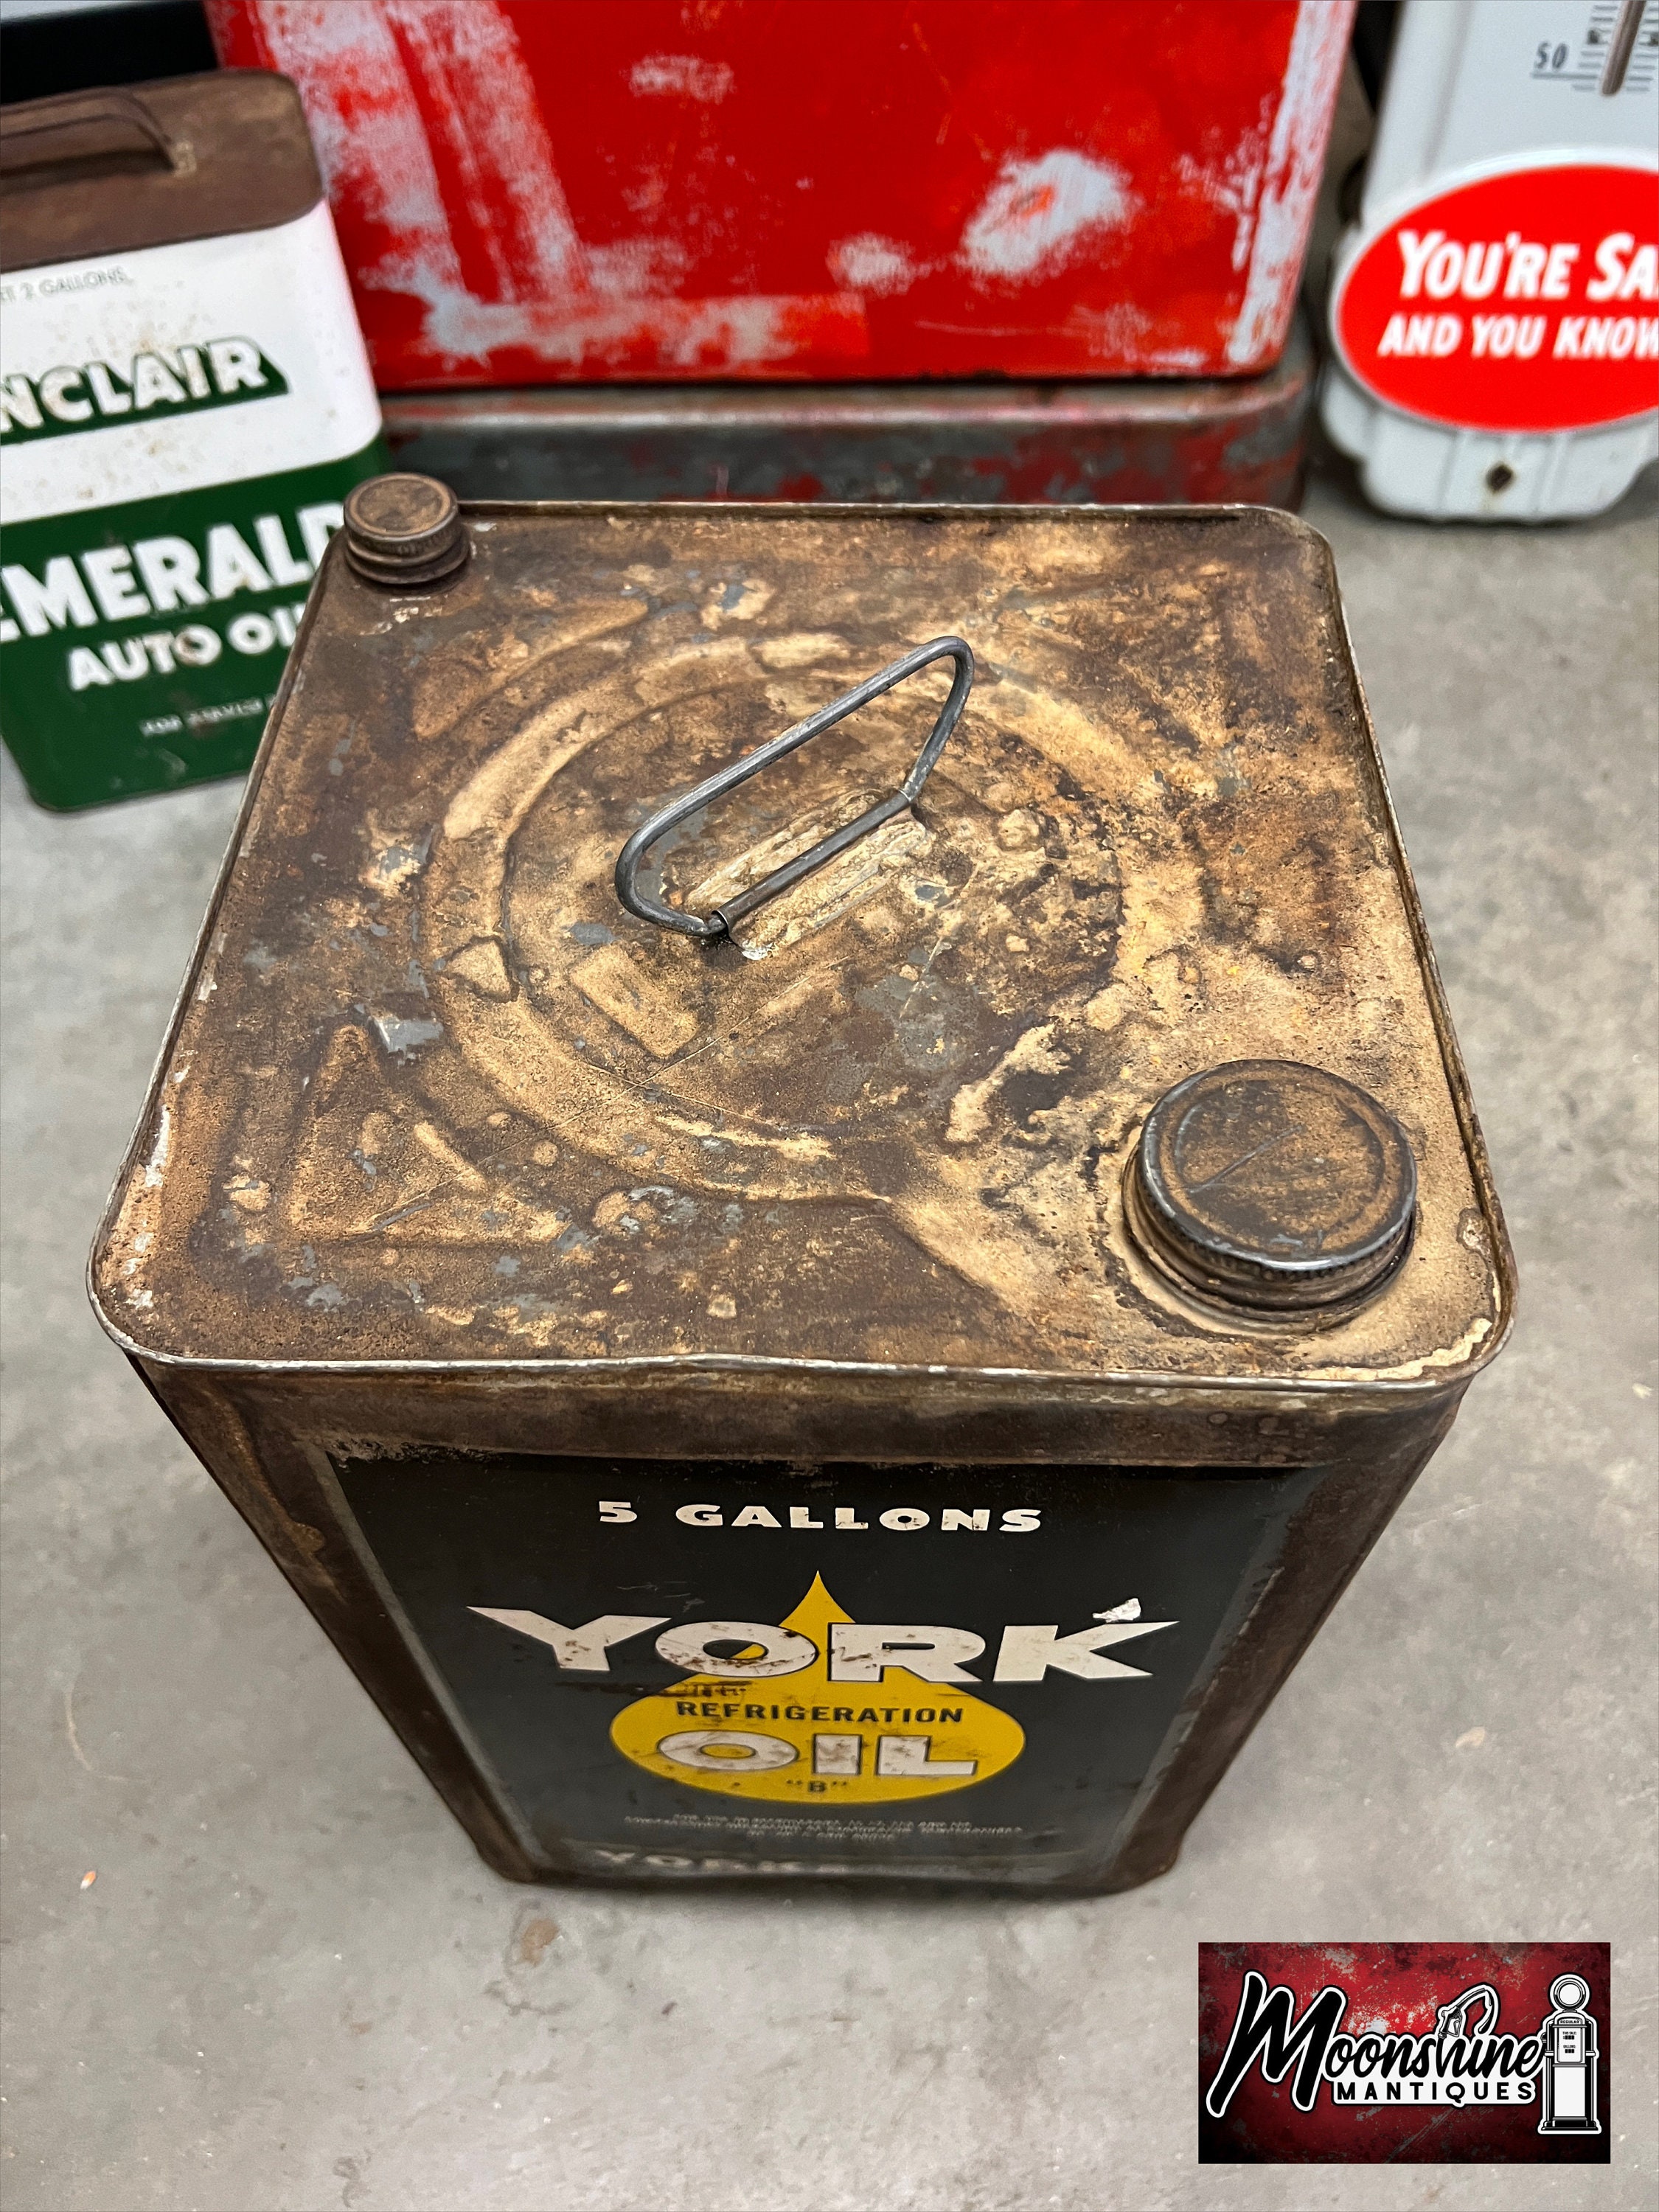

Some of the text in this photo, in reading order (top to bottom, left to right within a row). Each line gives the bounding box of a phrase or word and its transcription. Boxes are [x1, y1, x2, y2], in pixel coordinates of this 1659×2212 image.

[1534, 41, 1568, 69] 50
[1398, 229, 1579, 301] YOU'RE
[1377, 314, 1659, 361] AND YOU KNOW
[68, 623, 223, 692] AUTO
[598, 1500, 1043, 1532] 5 GALLONS
[466, 1605, 1180, 1683] YORK
[676, 1700, 964, 1724] REFRIGERATION
[656, 1729, 978, 1777] OIL
